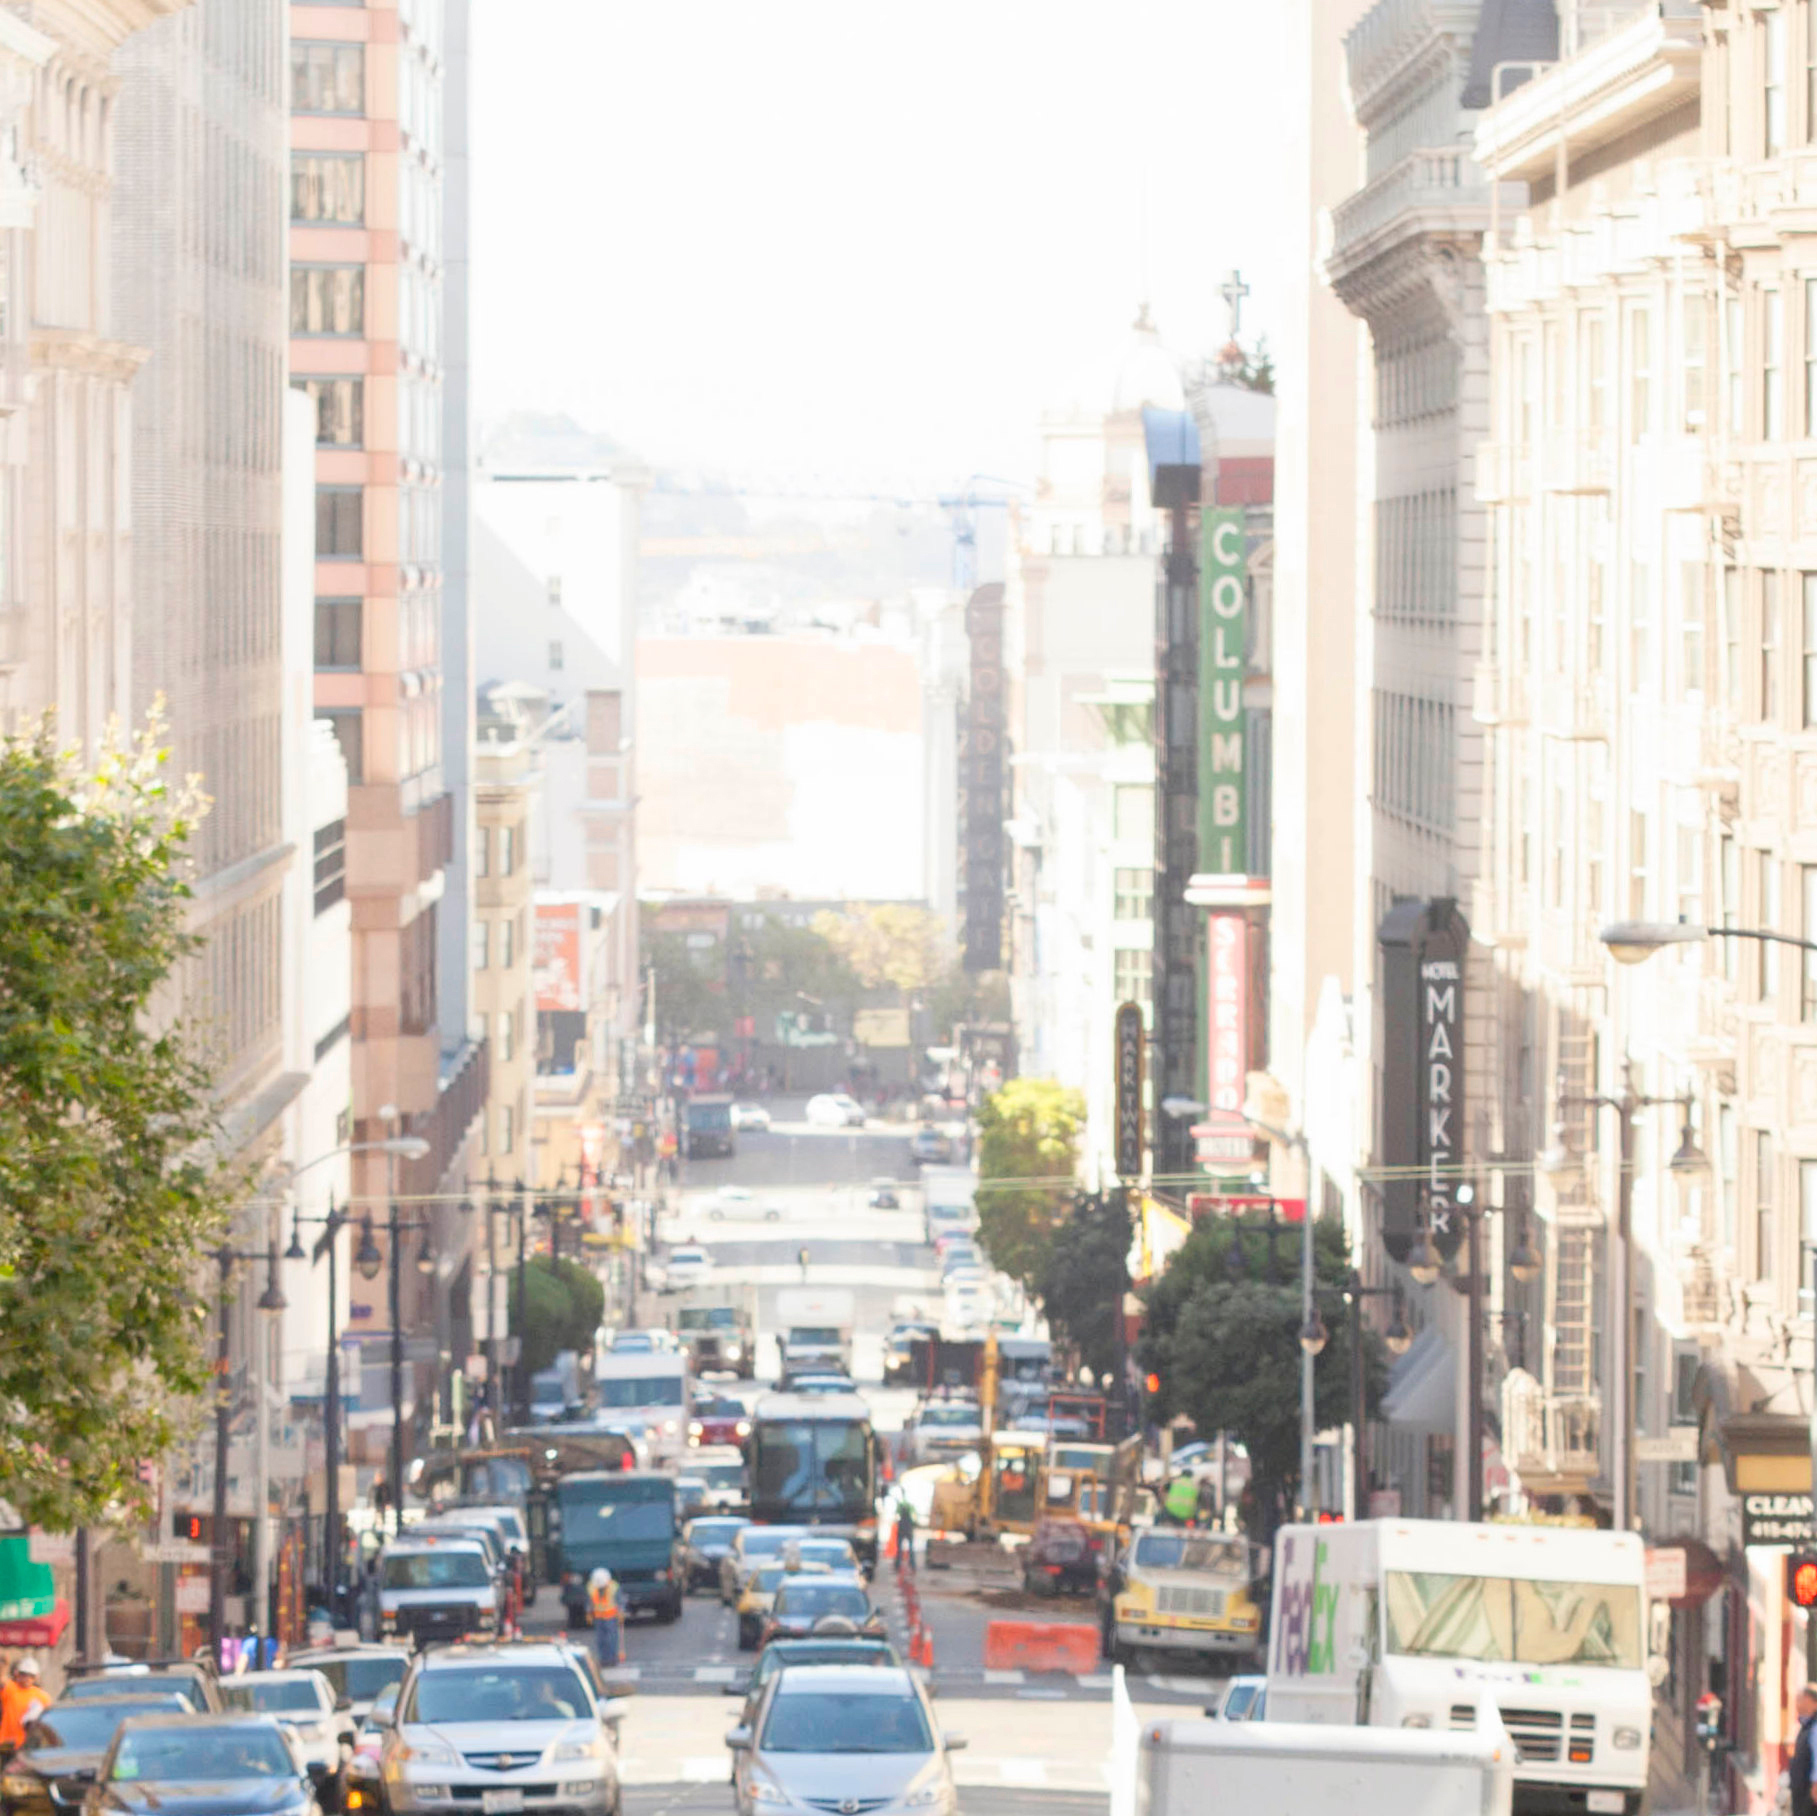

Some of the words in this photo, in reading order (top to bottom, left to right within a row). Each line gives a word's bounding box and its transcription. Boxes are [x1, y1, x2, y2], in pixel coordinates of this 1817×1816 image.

[1212, 522, 1244, 872] COLUMBI
[1422, 961, 1460, 981] HOTEL
[1426, 986, 1456, 1234] MARKER
